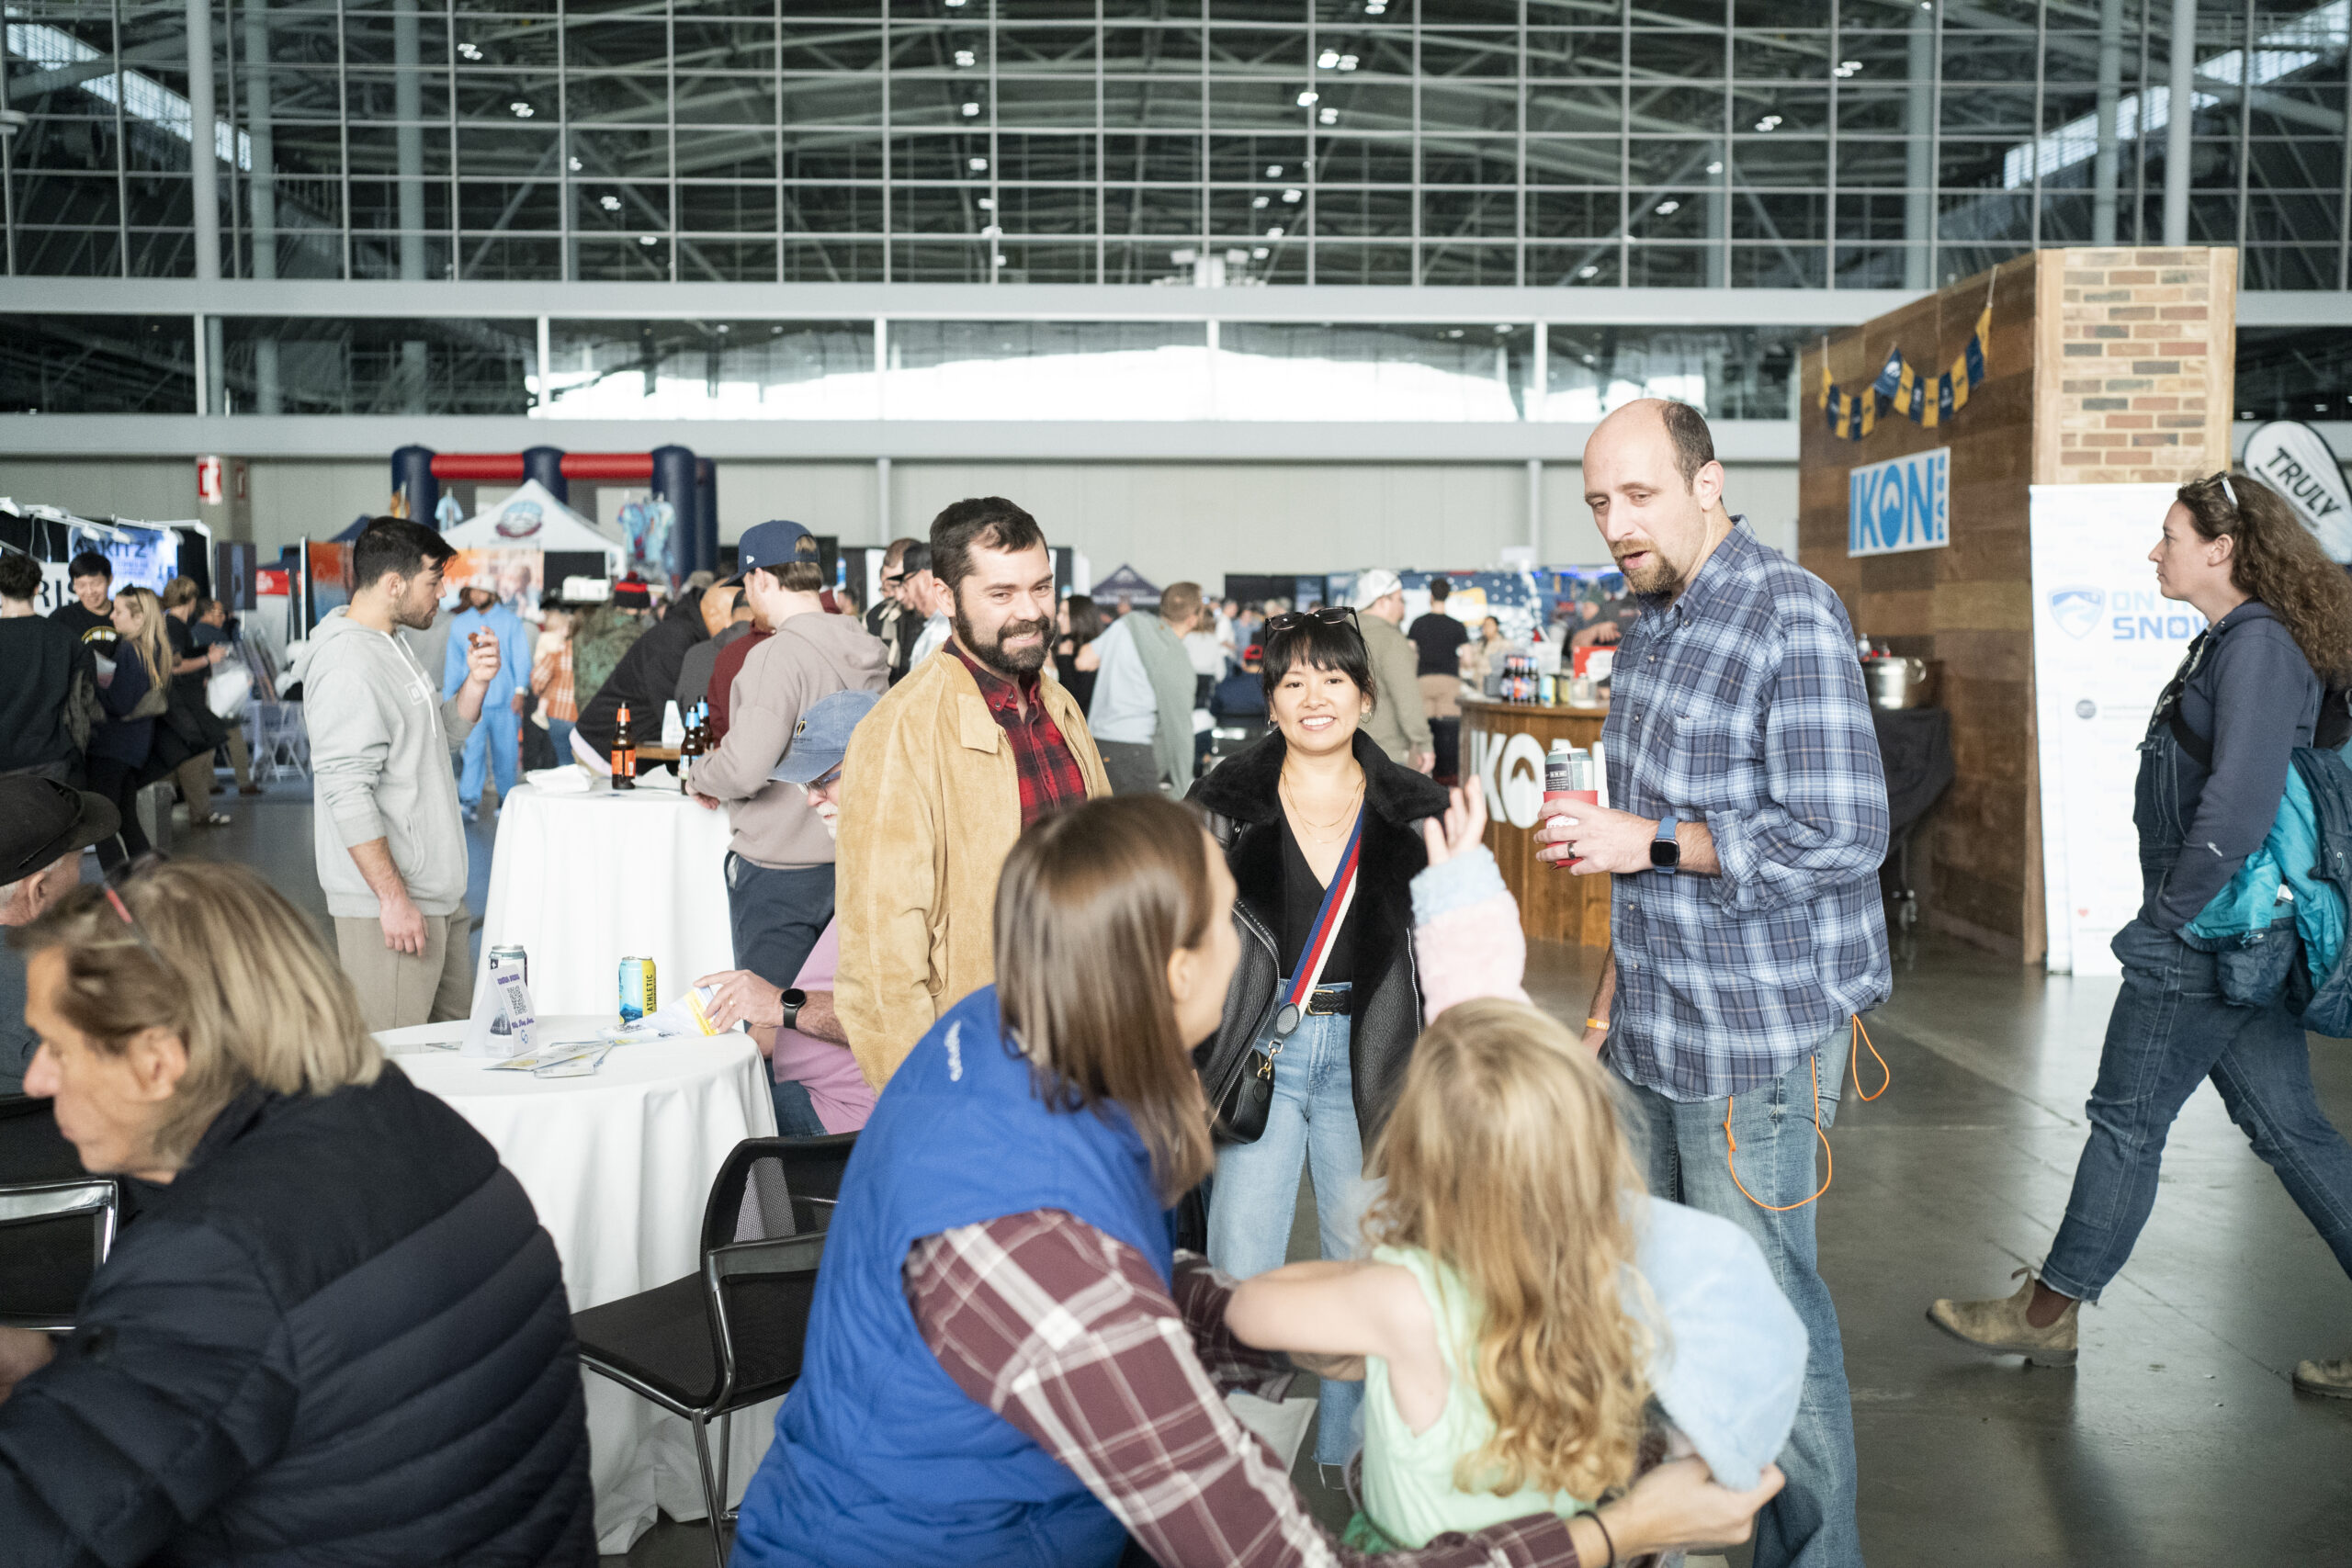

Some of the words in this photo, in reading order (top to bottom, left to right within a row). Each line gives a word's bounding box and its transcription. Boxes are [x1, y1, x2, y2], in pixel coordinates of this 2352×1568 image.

[1850, 457, 1934, 550] IKON
[2267, 447, 2342, 517] TRULY
[2112, 590, 2154, 612] ON
